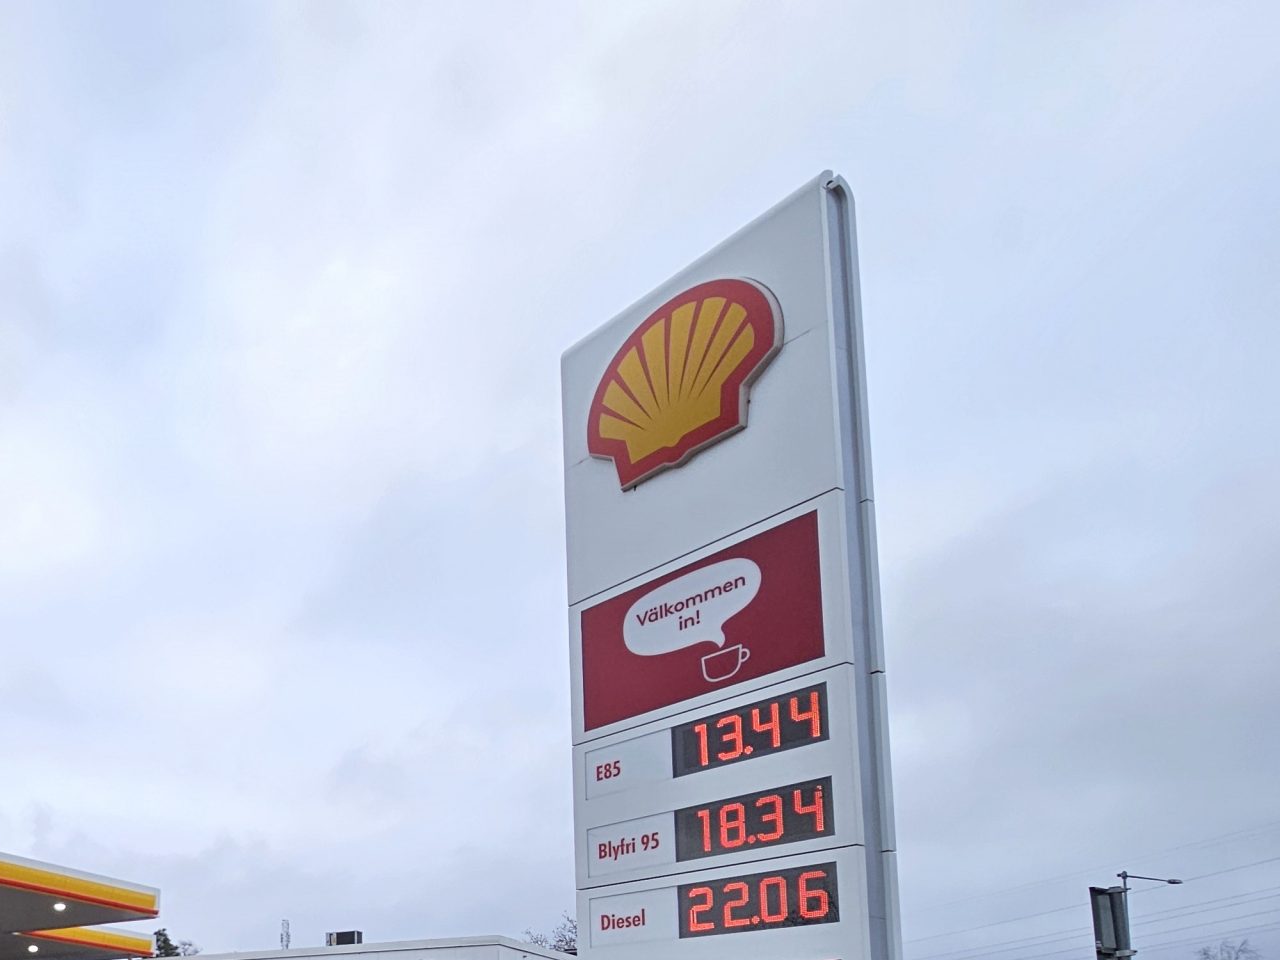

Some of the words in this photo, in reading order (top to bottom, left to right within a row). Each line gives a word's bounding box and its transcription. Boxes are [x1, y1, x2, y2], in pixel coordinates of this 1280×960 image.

[636, 576, 746, 626] Välkommen
[678, 610, 701, 631] in!
[694, 691, 821, 766] 13.44
[596, 760, 621, 781] E85
[697, 785, 824, 852] 18.34
[598, 837, 636, 865] Blyfri
[640, 832, 660, 851] 95
[601, 908, 646, 931] Diesel
[689, 870, 829, 932] 22.06
